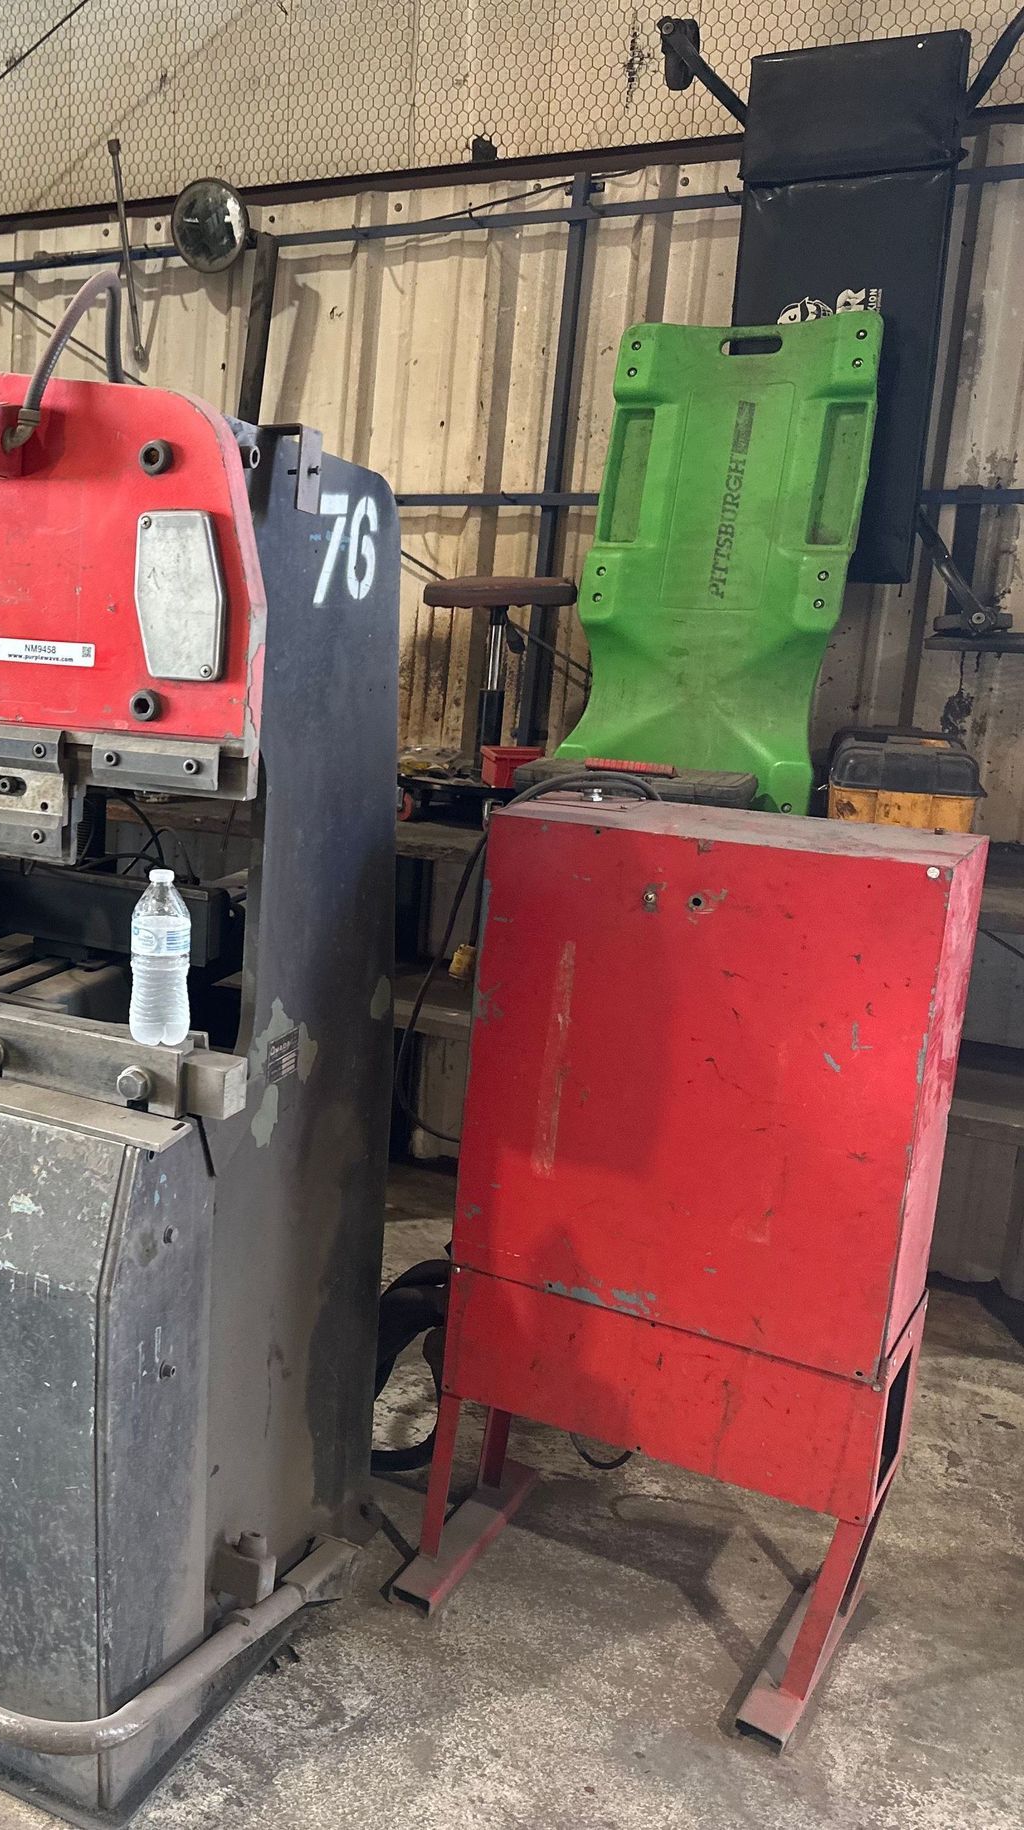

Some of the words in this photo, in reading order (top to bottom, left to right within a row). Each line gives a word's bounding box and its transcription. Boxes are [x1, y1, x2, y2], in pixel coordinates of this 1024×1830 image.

[313, 493, 378, 604] 76
[708, 453, 746, 600] PITTSBURGH
[8, 653, 74, 663] www.purplewave.com
[24, 644, 57, 654] NM9458
